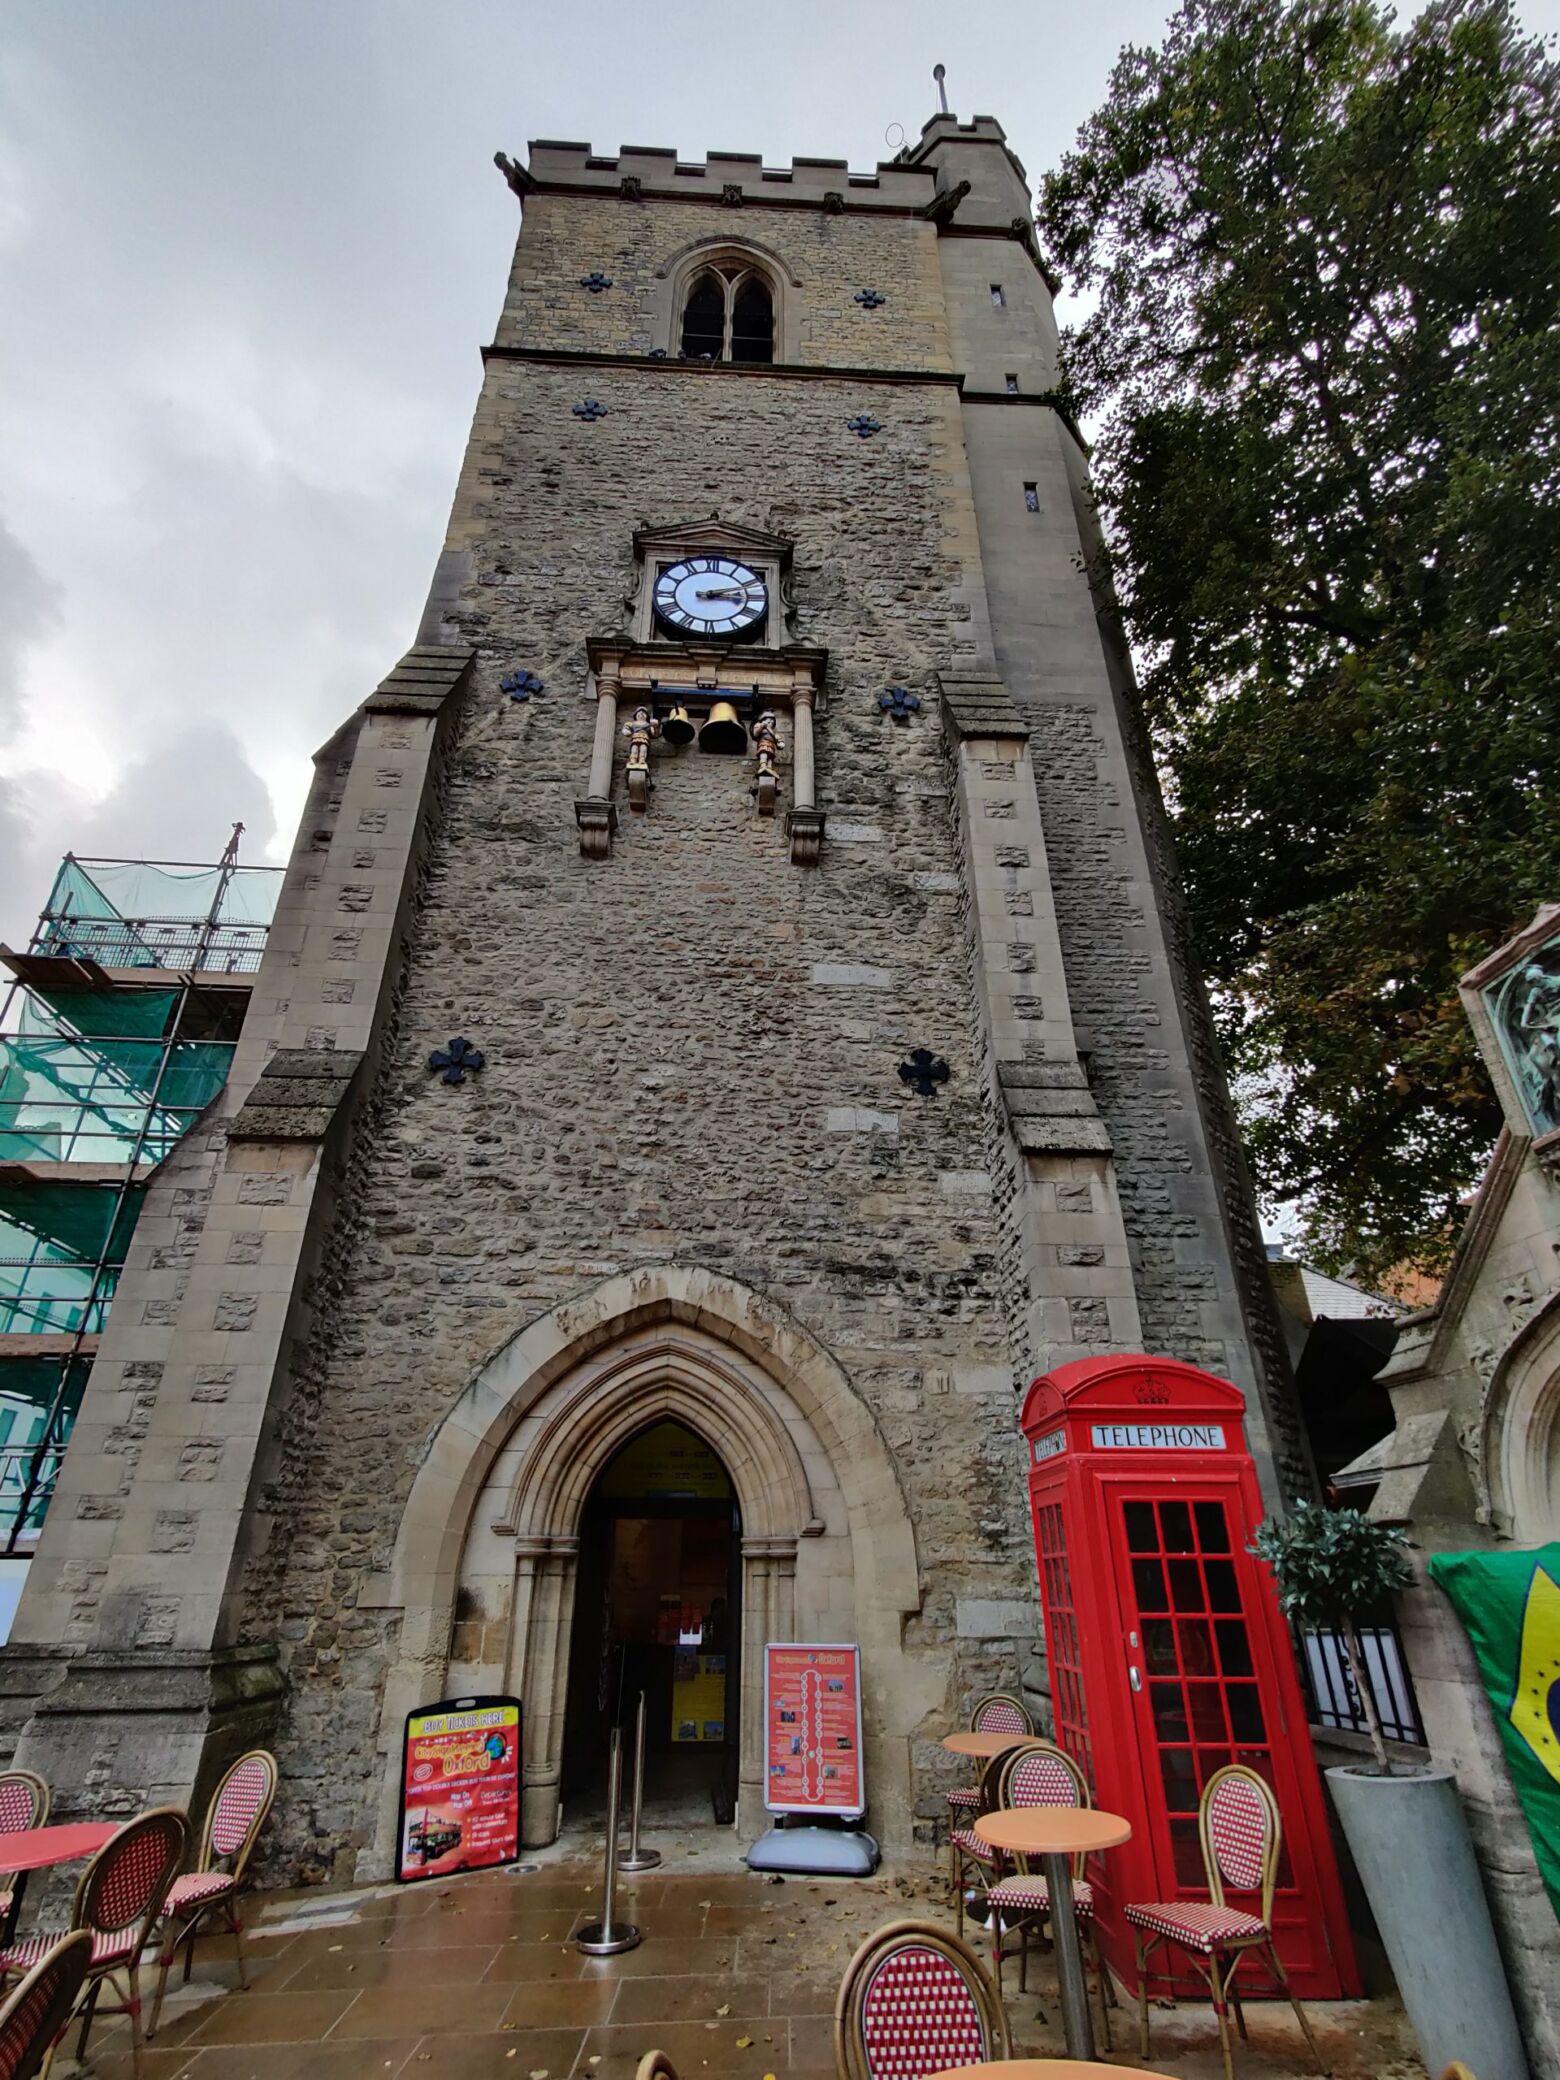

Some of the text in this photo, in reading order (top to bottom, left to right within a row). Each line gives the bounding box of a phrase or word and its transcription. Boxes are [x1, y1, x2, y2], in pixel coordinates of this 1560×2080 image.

[1034, 1430, 1064, 1459] TELEPHN
[1096, 1427, 1220, 1447] TELEPHONE
[424, 1711, 505, 1733] BUY TICKETS HERE
[443, 1750, 491, 1776] Oxford
